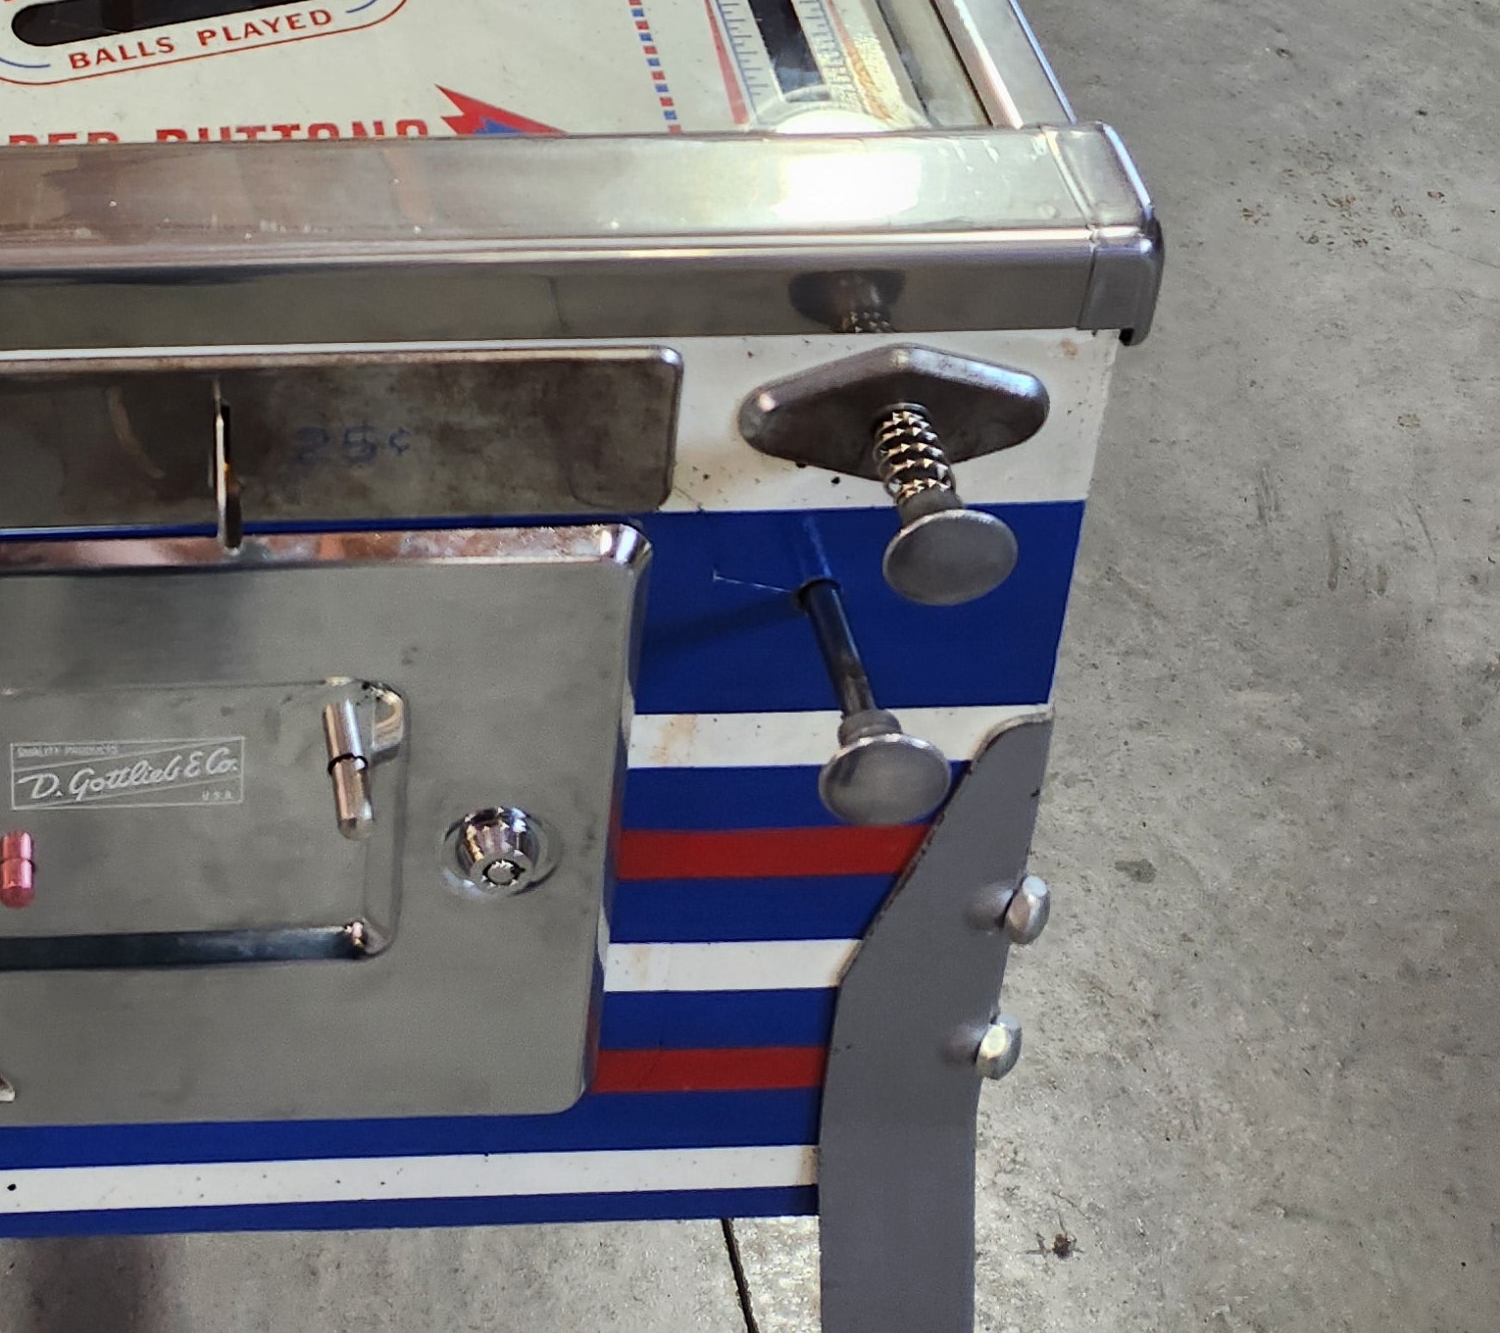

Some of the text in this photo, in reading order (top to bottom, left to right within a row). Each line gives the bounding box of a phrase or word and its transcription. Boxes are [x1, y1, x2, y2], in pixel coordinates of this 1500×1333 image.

[69, 9, 334, 70] BALLS PLAYED
[68, 747, 239, 802] Gottlieb Co.
